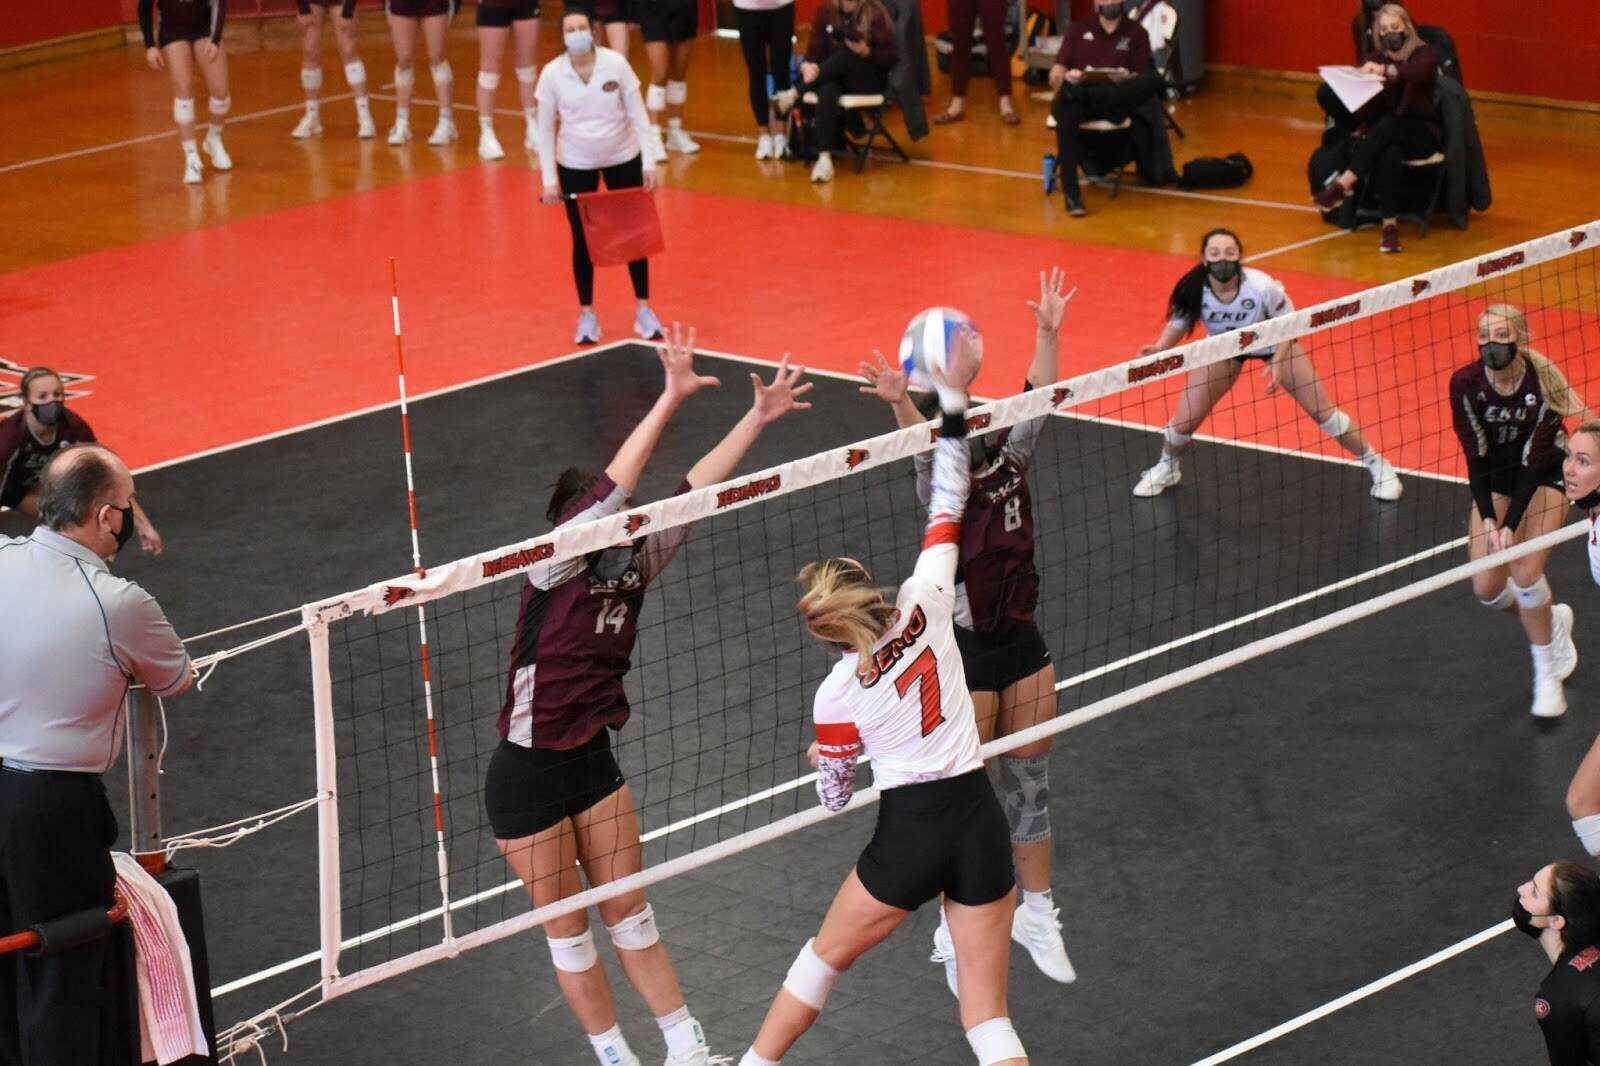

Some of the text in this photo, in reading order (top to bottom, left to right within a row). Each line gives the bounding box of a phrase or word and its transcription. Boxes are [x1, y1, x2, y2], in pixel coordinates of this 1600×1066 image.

[1209, 311, 1248, 323] EKU
[1484, 405, 1527, 422] EKU
[1004, 497, 1022, 532] 8
[482, 542, 554, 578] REDHAWKS
[595, 598, 628, 634] 14
[857, 604, 926, 689] SEMO
[894, 644, 946, 738] 7
